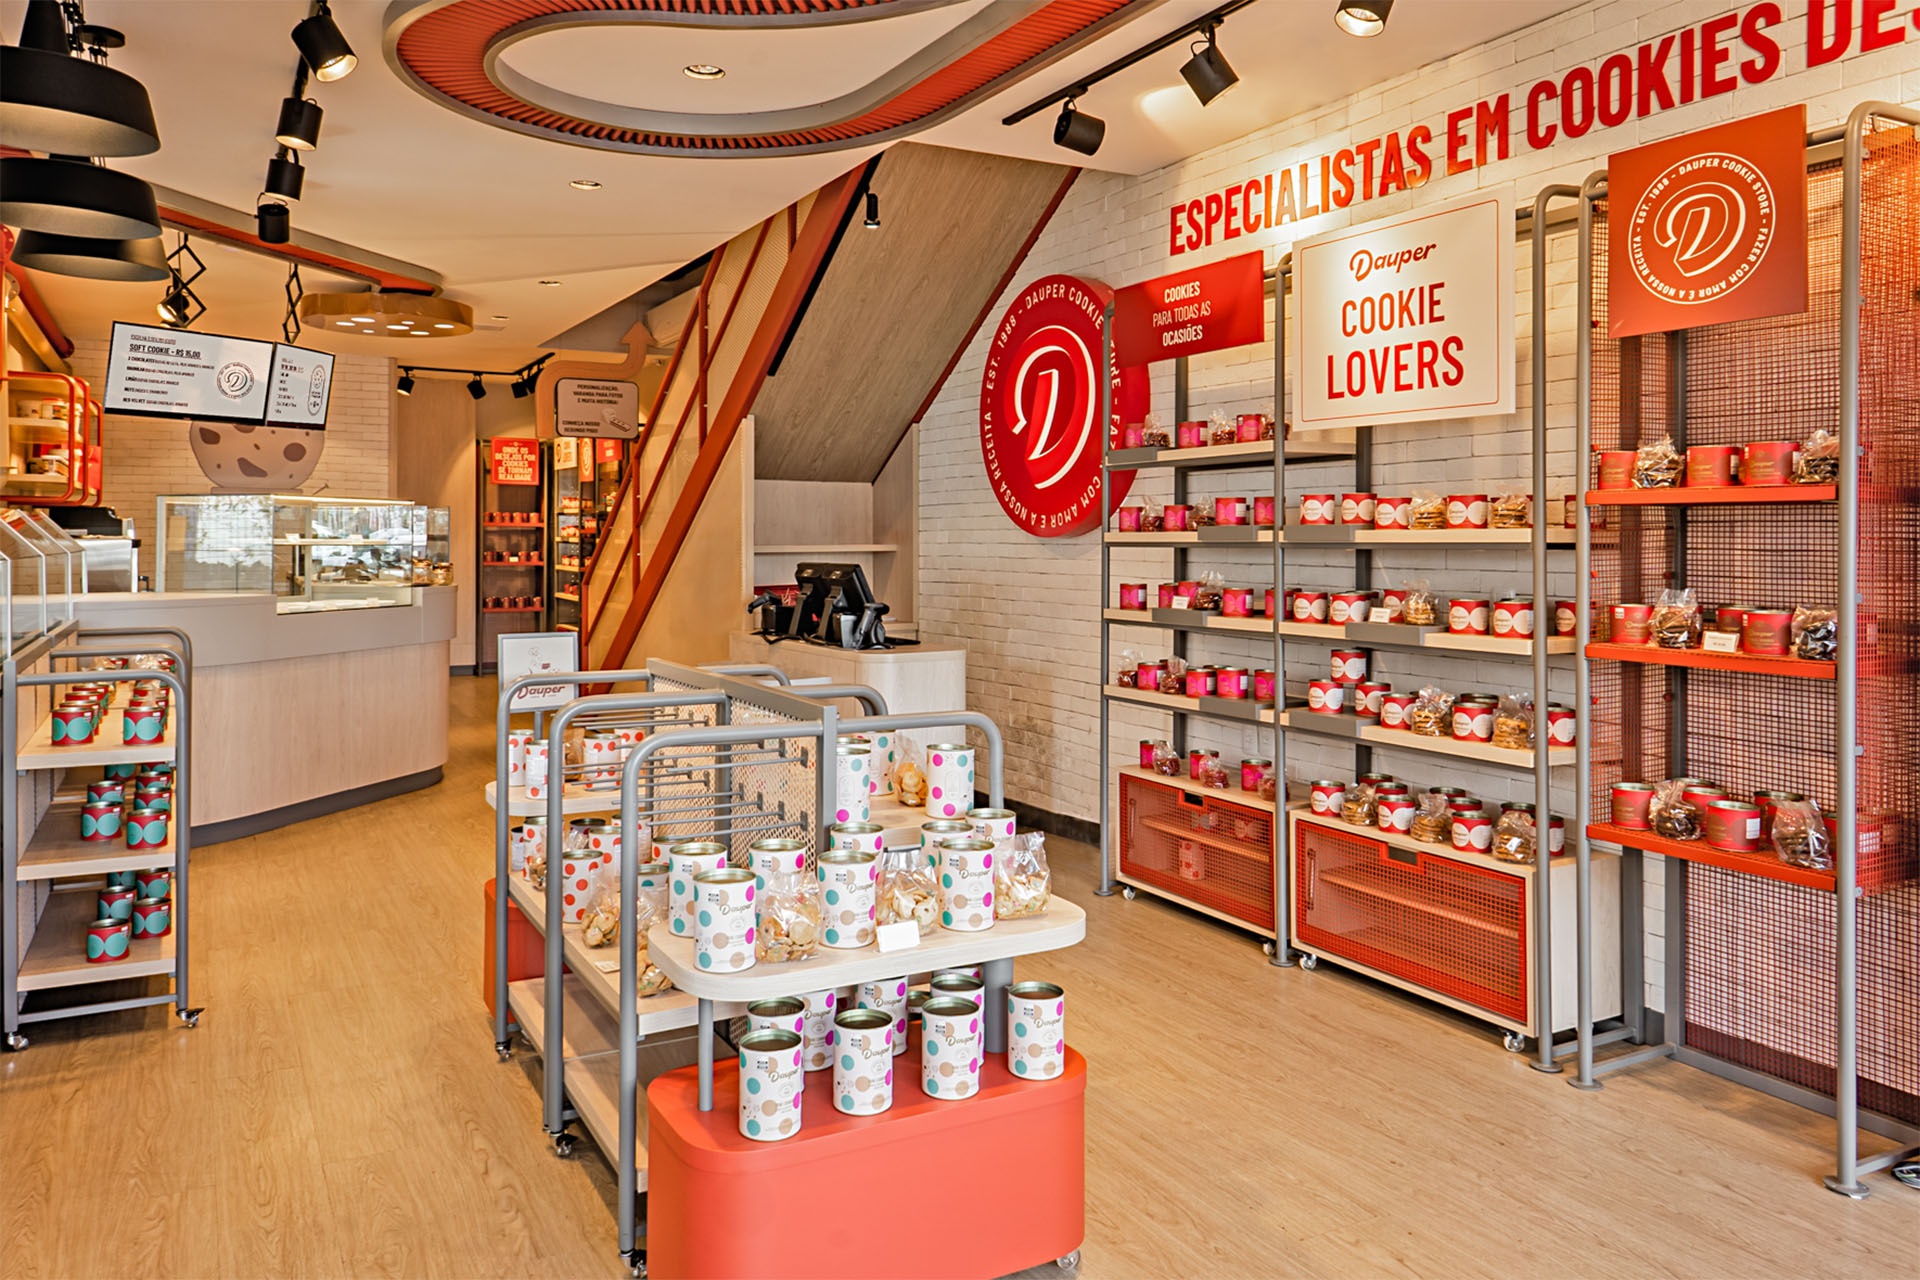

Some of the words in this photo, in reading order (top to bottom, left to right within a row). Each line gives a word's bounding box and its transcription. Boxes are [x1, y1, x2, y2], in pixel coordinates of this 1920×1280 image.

[1169, 125, 1433, 257] ESPECIALISTAS
[1447, 93, 1511, 177] EM
[1527, 2, 1784, 151] COOKIES
[1806, 0, 1920, 69] DE
[1679, 158, 1720, 176] DAUPER
[1722, 159, 1756, 184] COOKIE
[1752, 182, 1770, 215] STORE
[1636, 202, 1652, 224] EST.
[1633, 235, 1651, 277] RECEITA
[1747, 227, 1768, 262] FAZER
[1349, 243, 1438, 282] Dauper
[1728, 263, 1750, 283] COM
[1025, 284, 1065, 310] DAUPER
[1164, 281, 1200, 303] COOKIES
[1647, 274, 1676, 297] NOSSA
[1679, 289, 1686, 298] A
[1698, 280, 1727, 298] AMOR
[1068, 287, 1104, 330] COOKIE
[1153, 310, 1173, 328] PARA
[1174, 303, 1199, 323] TODAS
[1200, 300, 1212, 317] AS
[1341, 282, 1445, 338] COOKIE
[998, 314, 1017, 349] 1988
[1162, 323, 1203, 347] OCASIÕES
[129, 343, 147, 353] SOFT
[147, 346, 171, 354] COOKIE
[986, 356, 1001, 390] EST.
[1327, 335, 1465, 400] LOVERS
[984, 411, 1002, 480] RECEITA
[1000, 480, 1028, 521] NOSSA
[1080, 475, 1102, 508] COM
[1031, 512, 1037, 526] A
[1050, 503, 1078, 528] AMOR
[516, 683, 565, 699] Dauper
